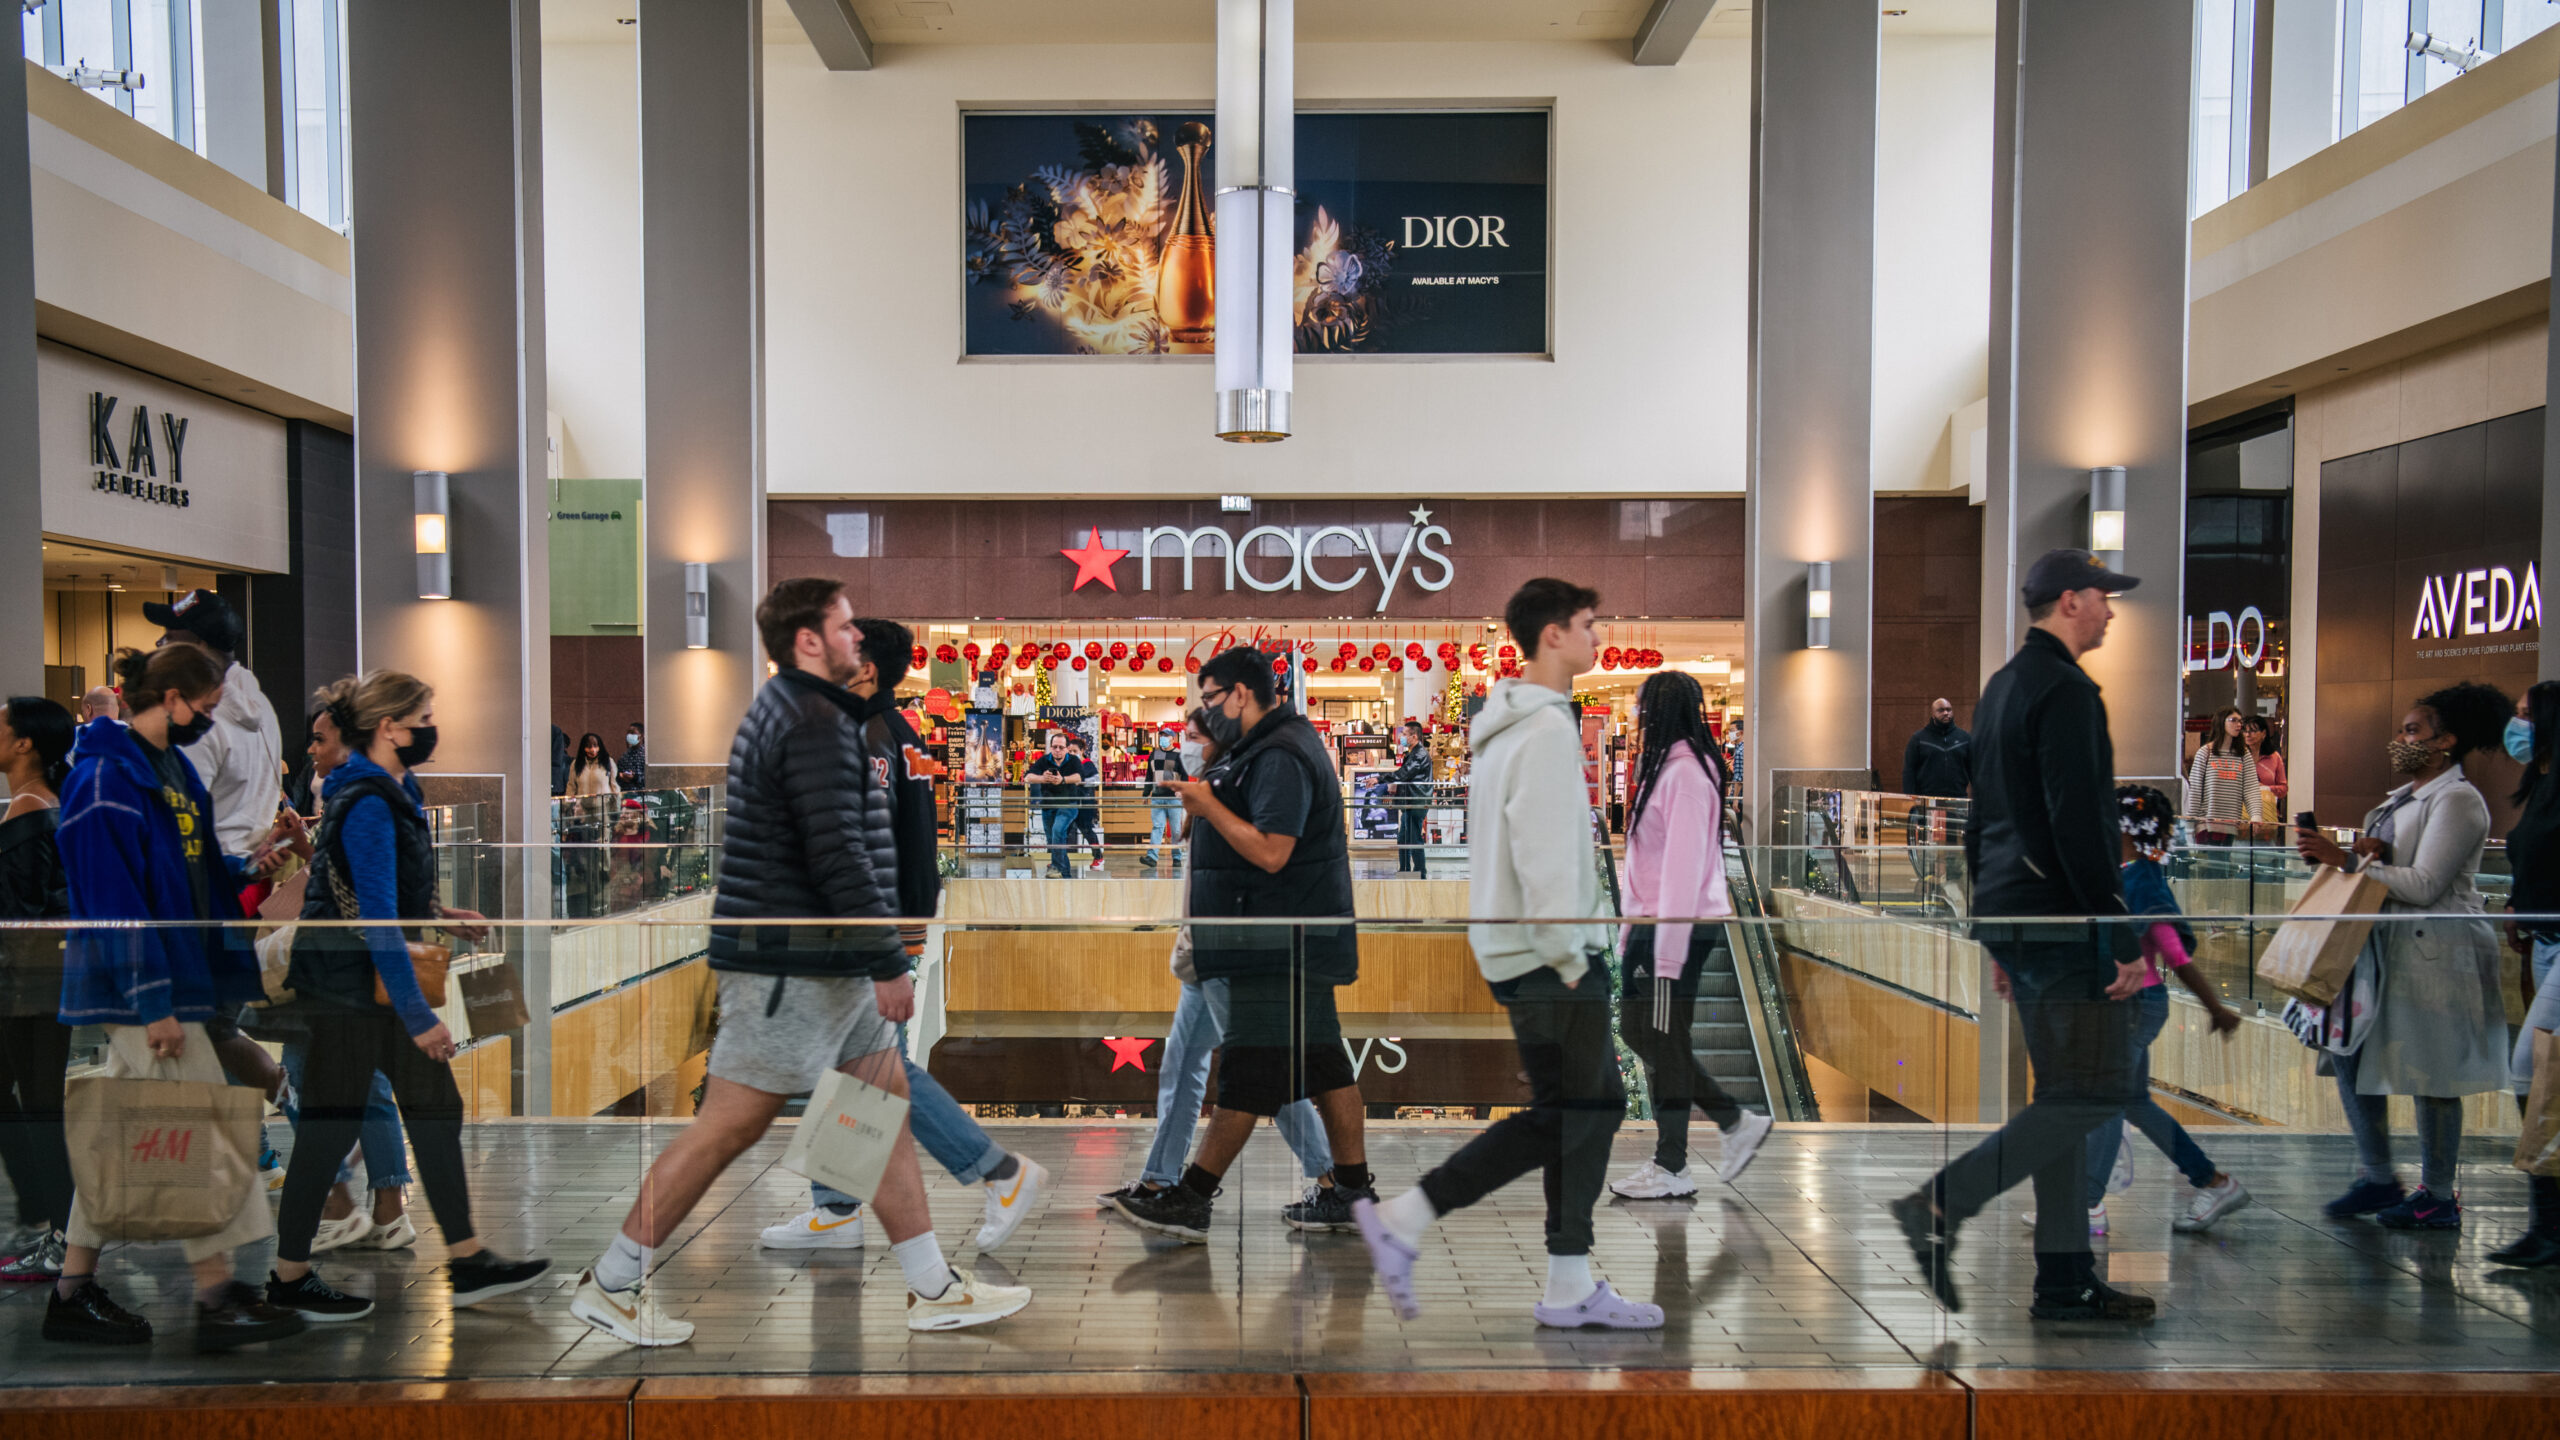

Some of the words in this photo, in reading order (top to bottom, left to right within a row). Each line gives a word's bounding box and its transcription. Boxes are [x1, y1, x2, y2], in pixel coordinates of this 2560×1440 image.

[1401, 215, 1510, 248] DIOR
[1412, 277, 1454, 285] AVAILABLE
[1456, 277, 1466, 285] AT
[1468, 276, 1499, 285] MACY'S
[95, 391, 189, 483] KAY
[97, 470, 190, 508] JEWELERS
[557, 511, 580, 520] Green
[581, 511, 609, 522] Garage
[2411, 560, 2542, 640] AVEDA
[2186, 605, 2265, 672] LDO
[2416, 650, 2425, 658] THE
[2481, 645, 2498, 654] FLOWER
[2499, 644, 2509, 652] AND
[2510, 643, 2524, 651] PLANT
[1046, 707, 1078, 718] DIOR
[132, 1128, 193, 1164] H&M
